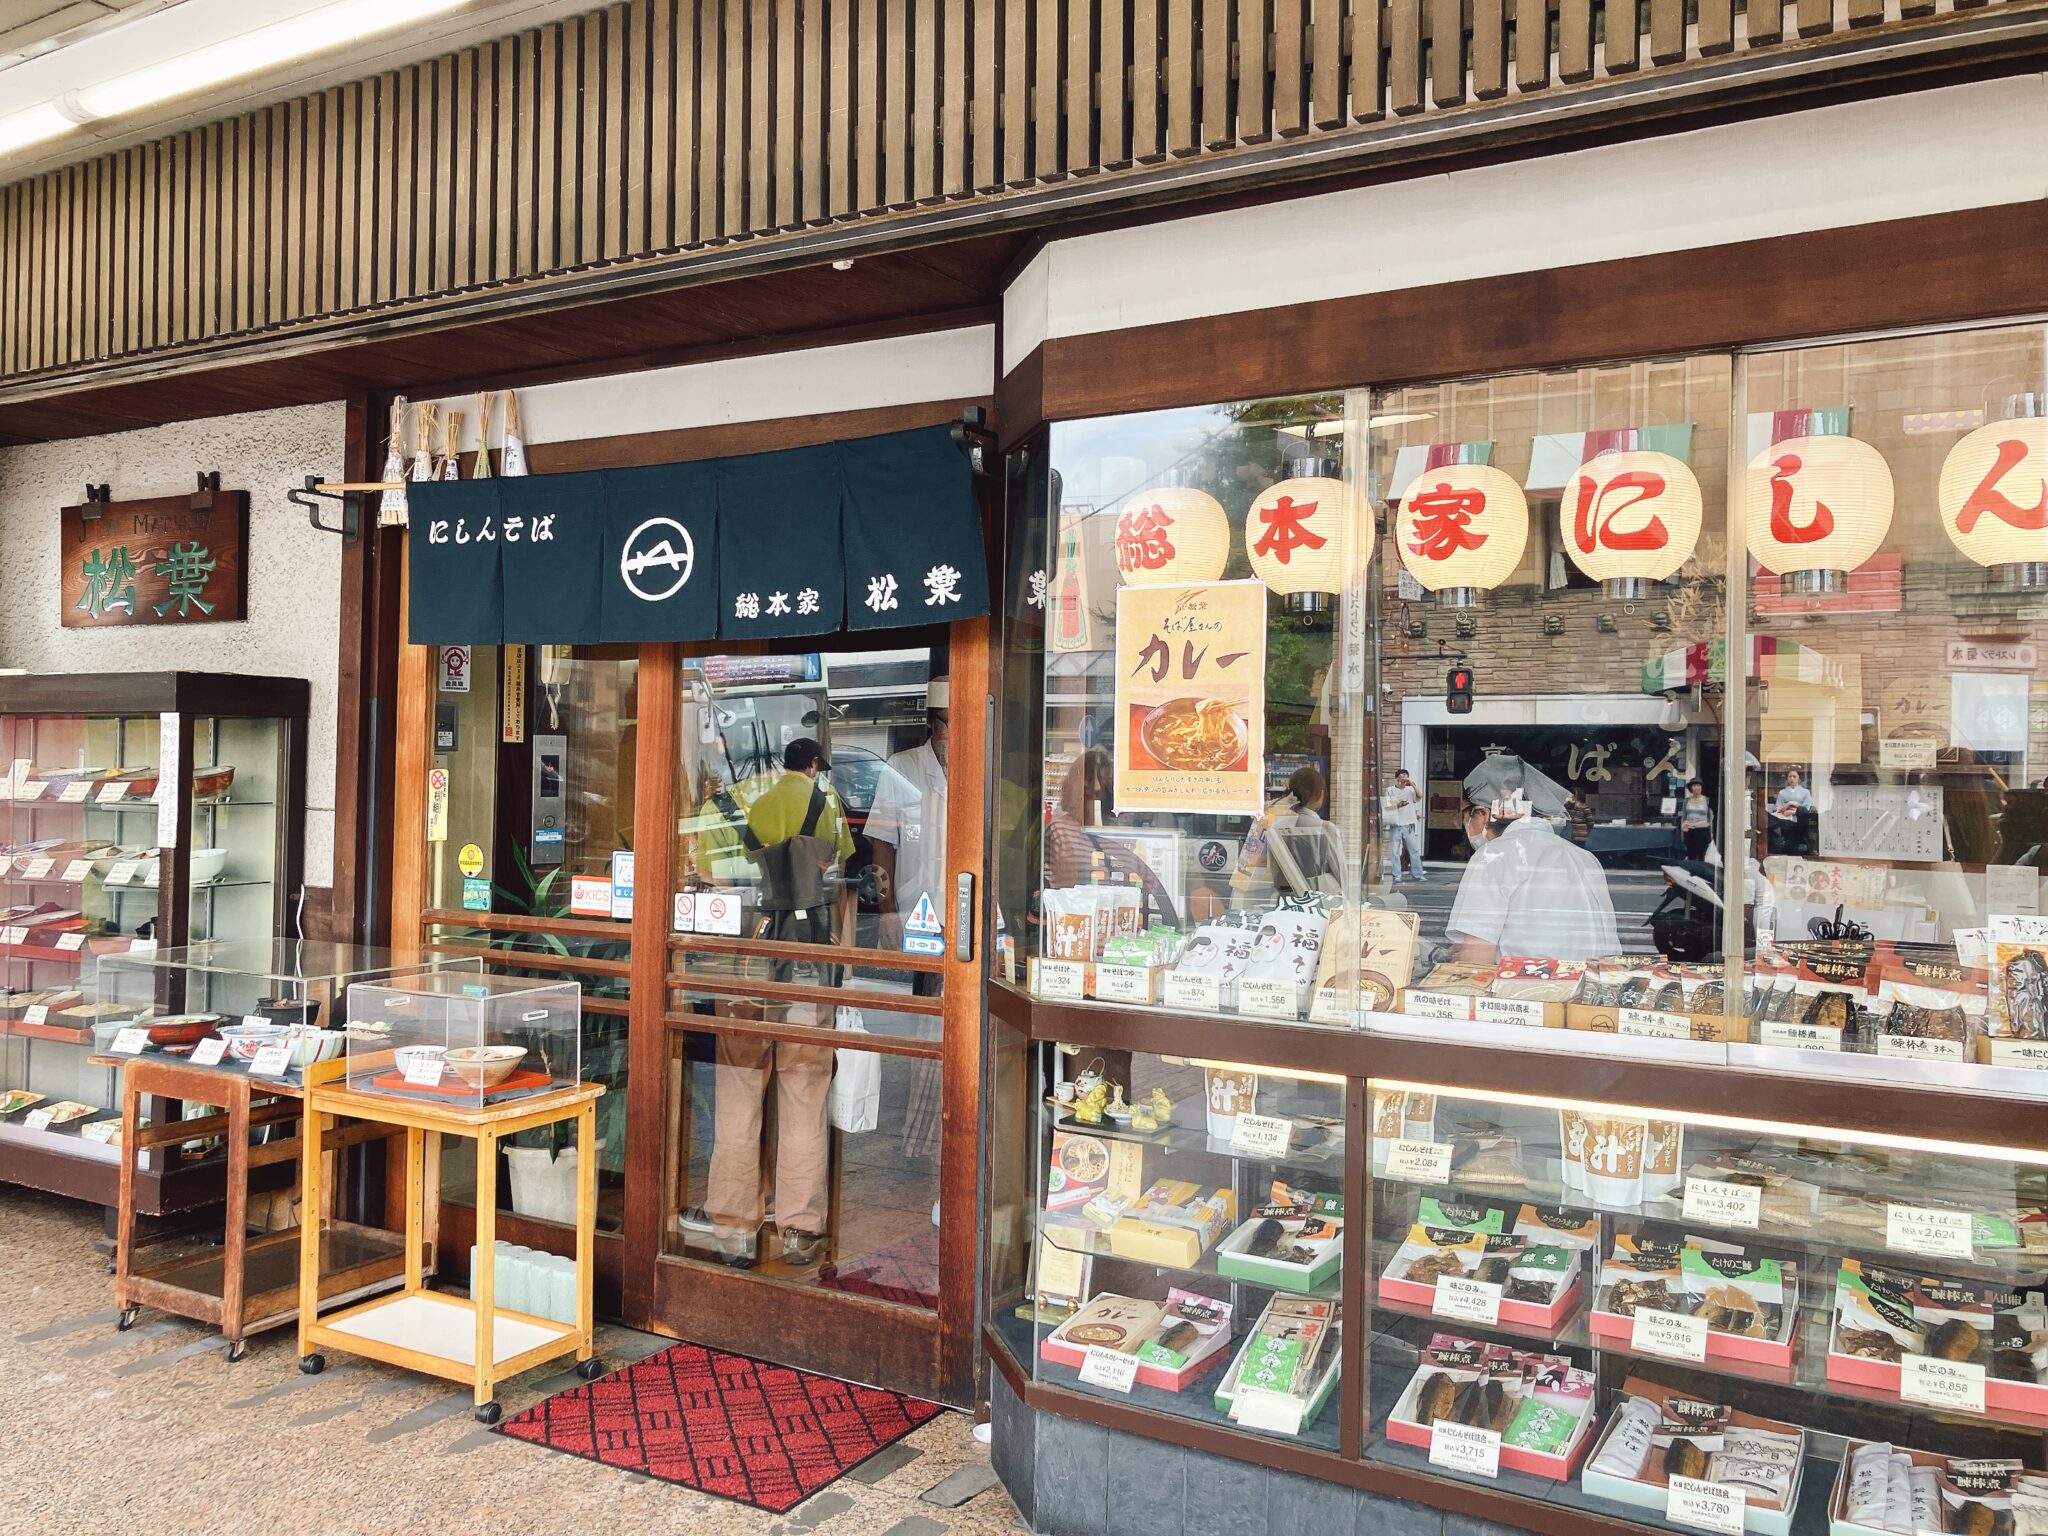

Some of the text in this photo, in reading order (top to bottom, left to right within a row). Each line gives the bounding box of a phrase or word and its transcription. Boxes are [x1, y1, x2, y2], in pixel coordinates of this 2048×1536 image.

[428, 513, 557, 545] にしんそば
[76, 541, 217, 620] 松葉
[864, 564, 962, 613] 松葉
[734, 587, 820, 619] 総本家
[1130, 633, 1251, 684] カレー
[1815, 962, 1860, 979] 鰊棒煮
[1914, 962, 1962, 982] 鰊棒煮
[1413, 994, 1452, 1006] 京の味そば
[1691, 1183, 1741, 1197] にしんそば
[1894, 1210, 1949, 1225] にしんそば
[1711, 1257, 1753, 1271] たけのこ鰊
[1931, 1288, 1976, 1304] 鰊棒煮
[1648, 1315, 1683, 1329] 味ごのみ
[1918, 1363, 1957, 1376] 味ごのみ
